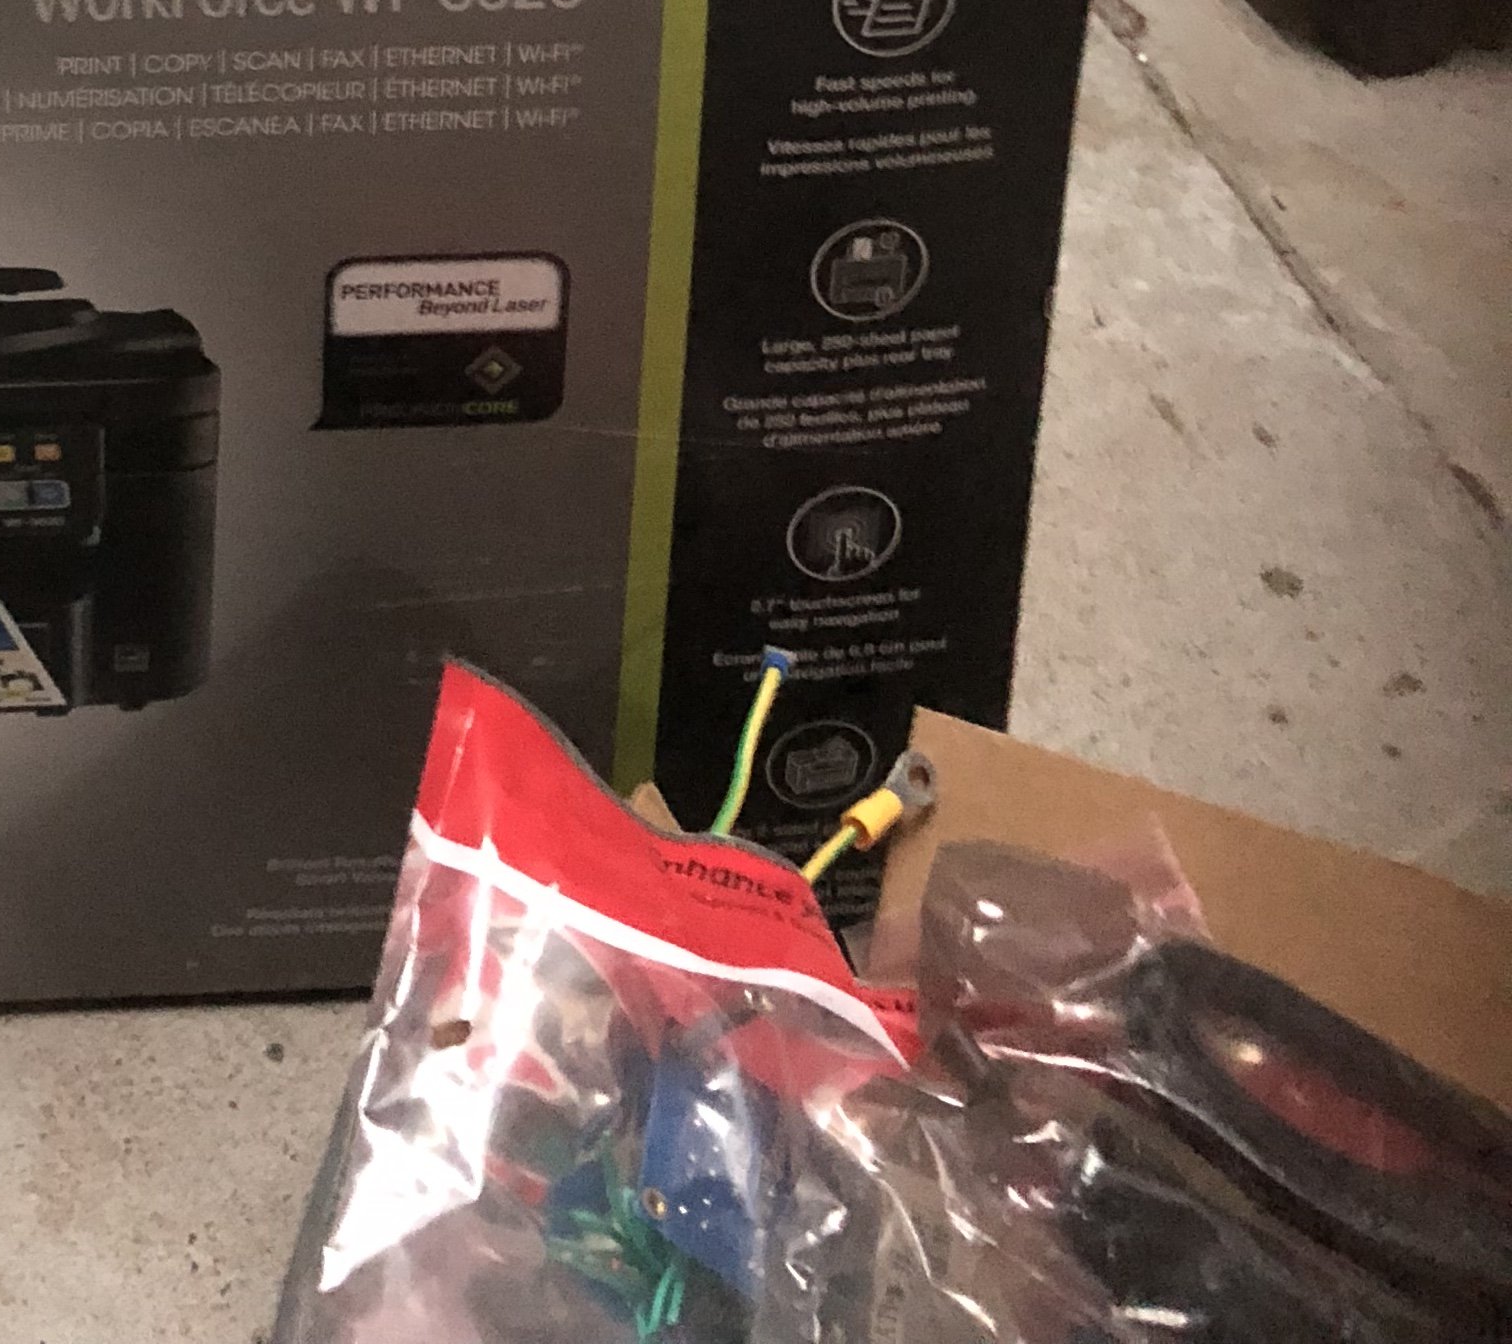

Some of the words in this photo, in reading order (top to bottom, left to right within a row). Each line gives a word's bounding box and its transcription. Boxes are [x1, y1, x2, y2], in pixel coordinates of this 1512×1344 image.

[56, 54, 124, 75] PRINT
[144, 51, 213, 74] COPY
[232, 50, 302, 71] SCAN
[321, 48, 365, 69] FAX
[386, 44, 497, 67] ETHERNET
[91, 119, 170, 141] COPIA
[321, 112, 364, 133] FAX
[384, 109, 497, 132] ETHERNET
[340, 279, 501, 301] PERFORMANCE
[418, 297, 489, 319] Beyond
[492, 297, 548, 314] Laser
